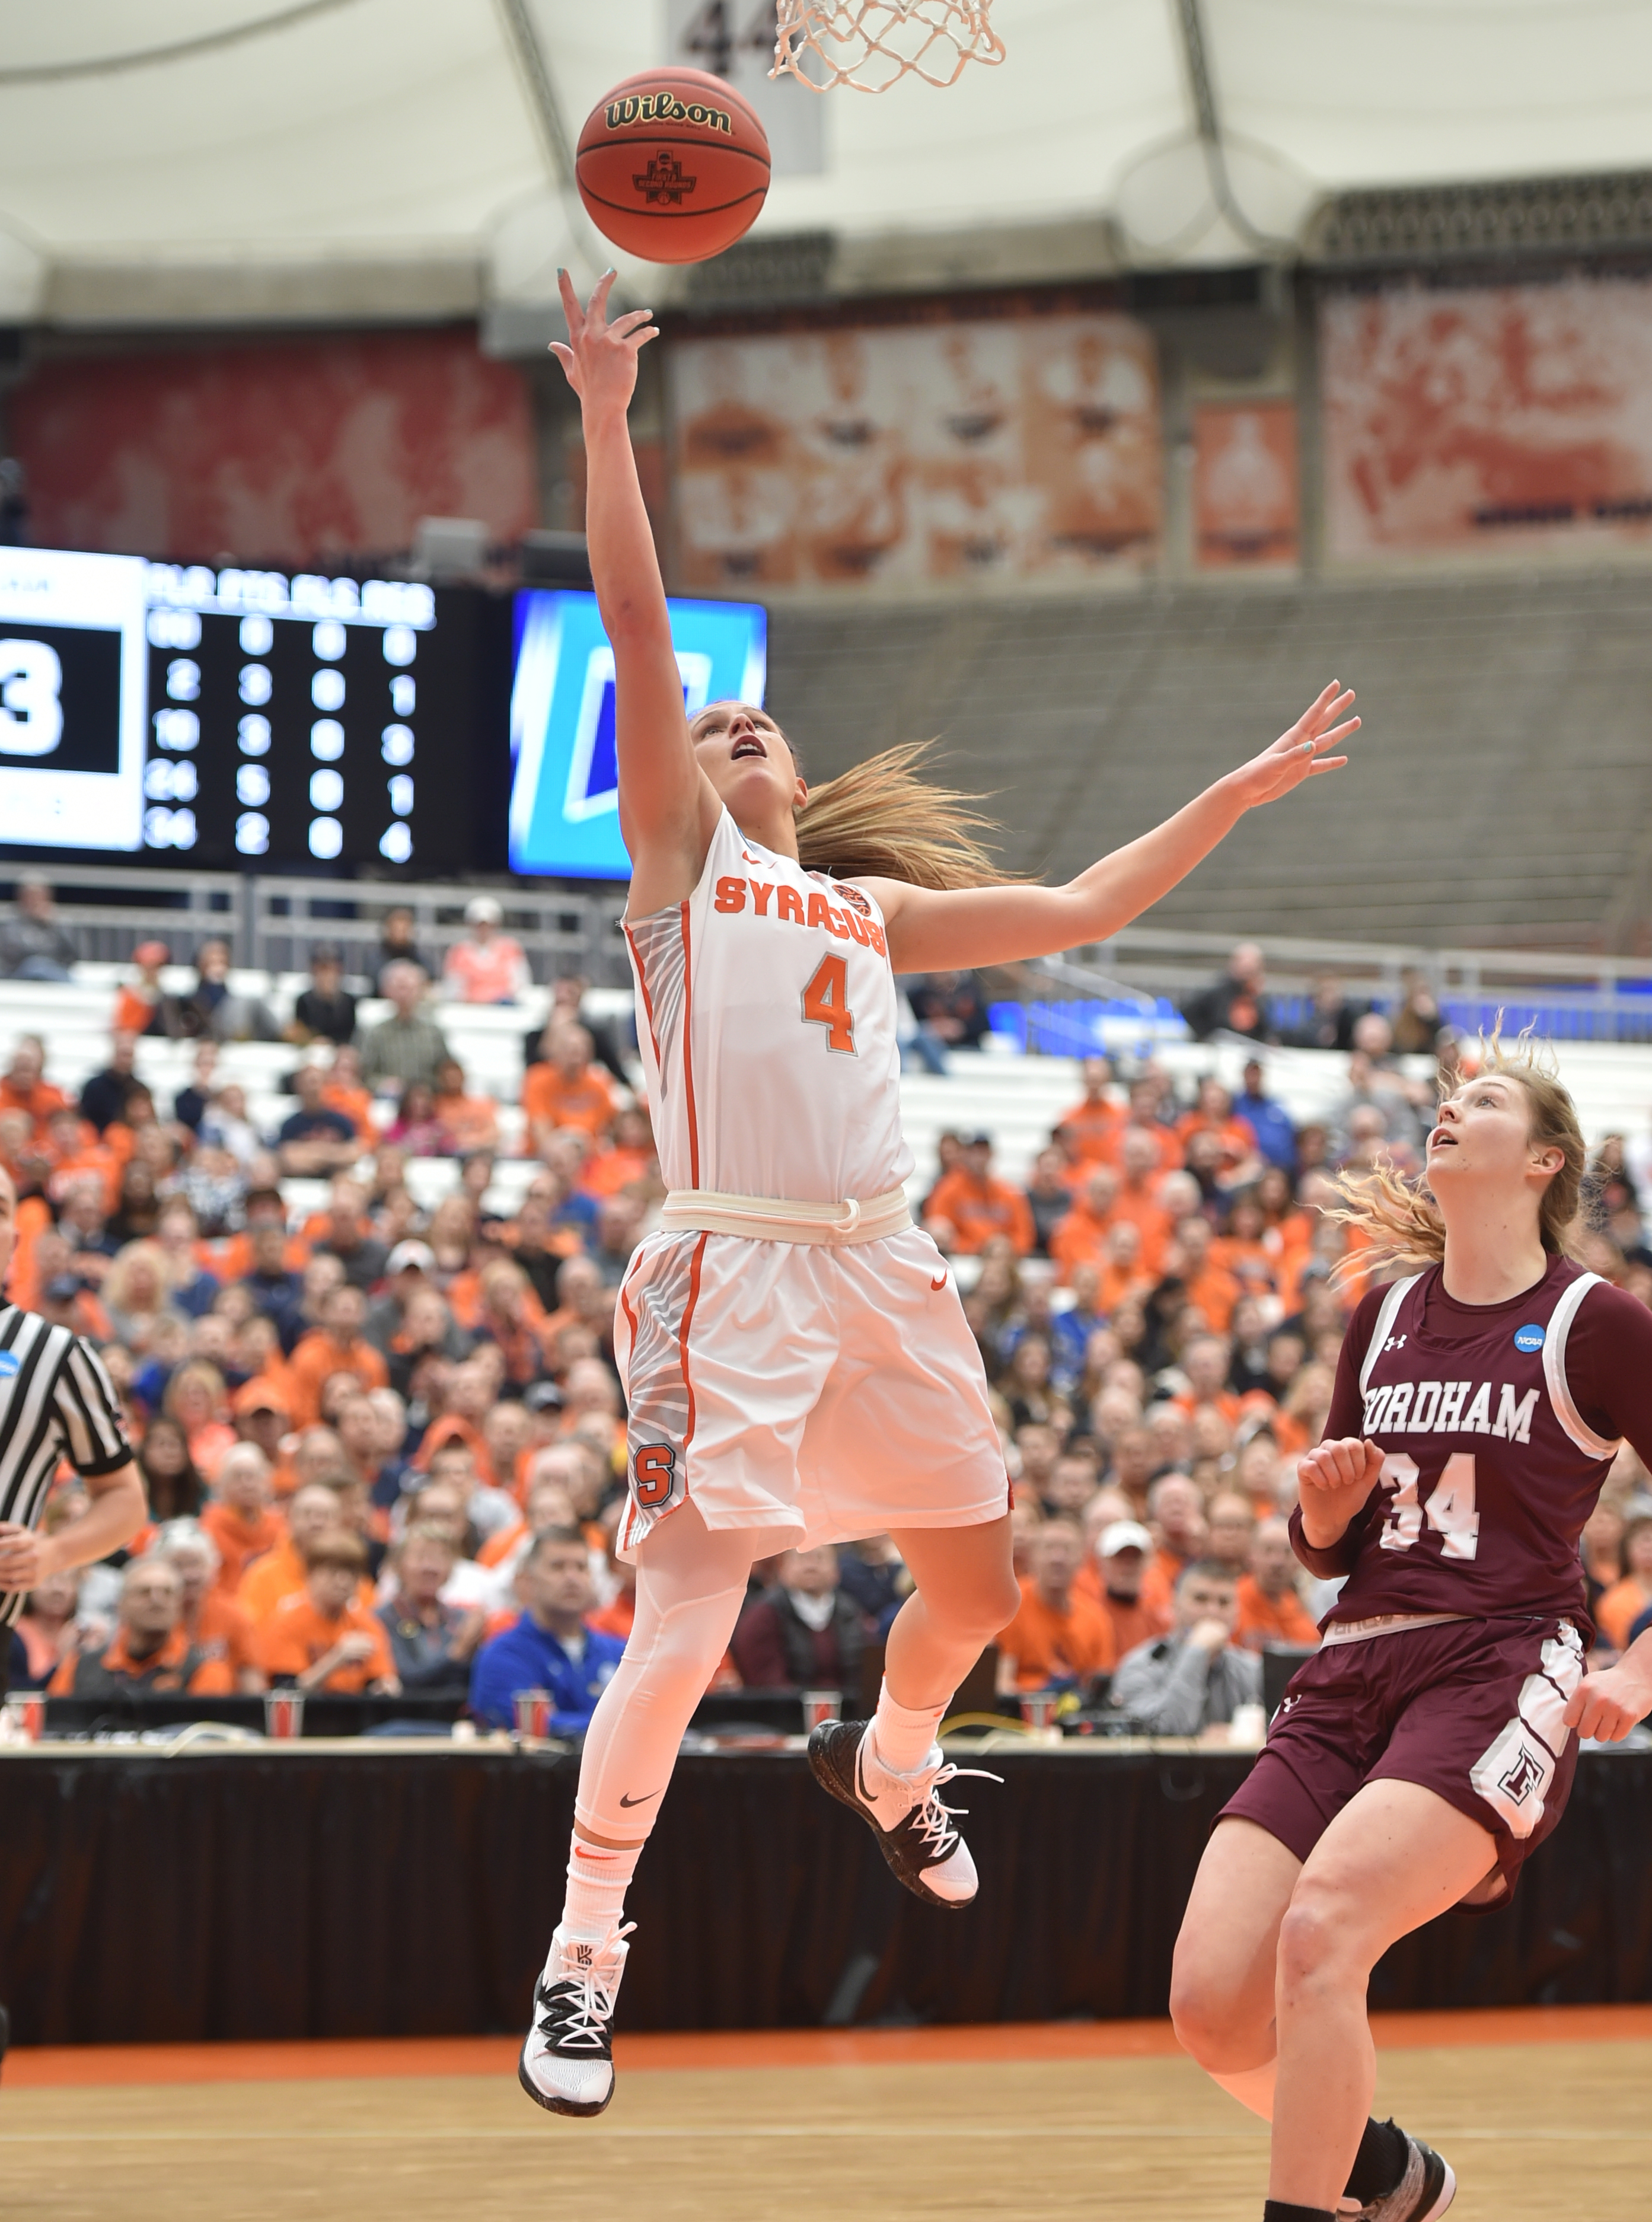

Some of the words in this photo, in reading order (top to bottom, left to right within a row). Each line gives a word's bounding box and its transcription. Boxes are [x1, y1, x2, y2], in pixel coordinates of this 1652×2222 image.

[604, 91, 732, 135] Wilson
[0, 639, 62, 756] 3
[714, 876, 886, 958] SYRACUS
[801, 951, 858, 1057] 4
[1517, 1337, 1542, 1346] NCAA
[633, 1443, 675, 1509] S
[1379, 1452, 1480, 1560] 34
